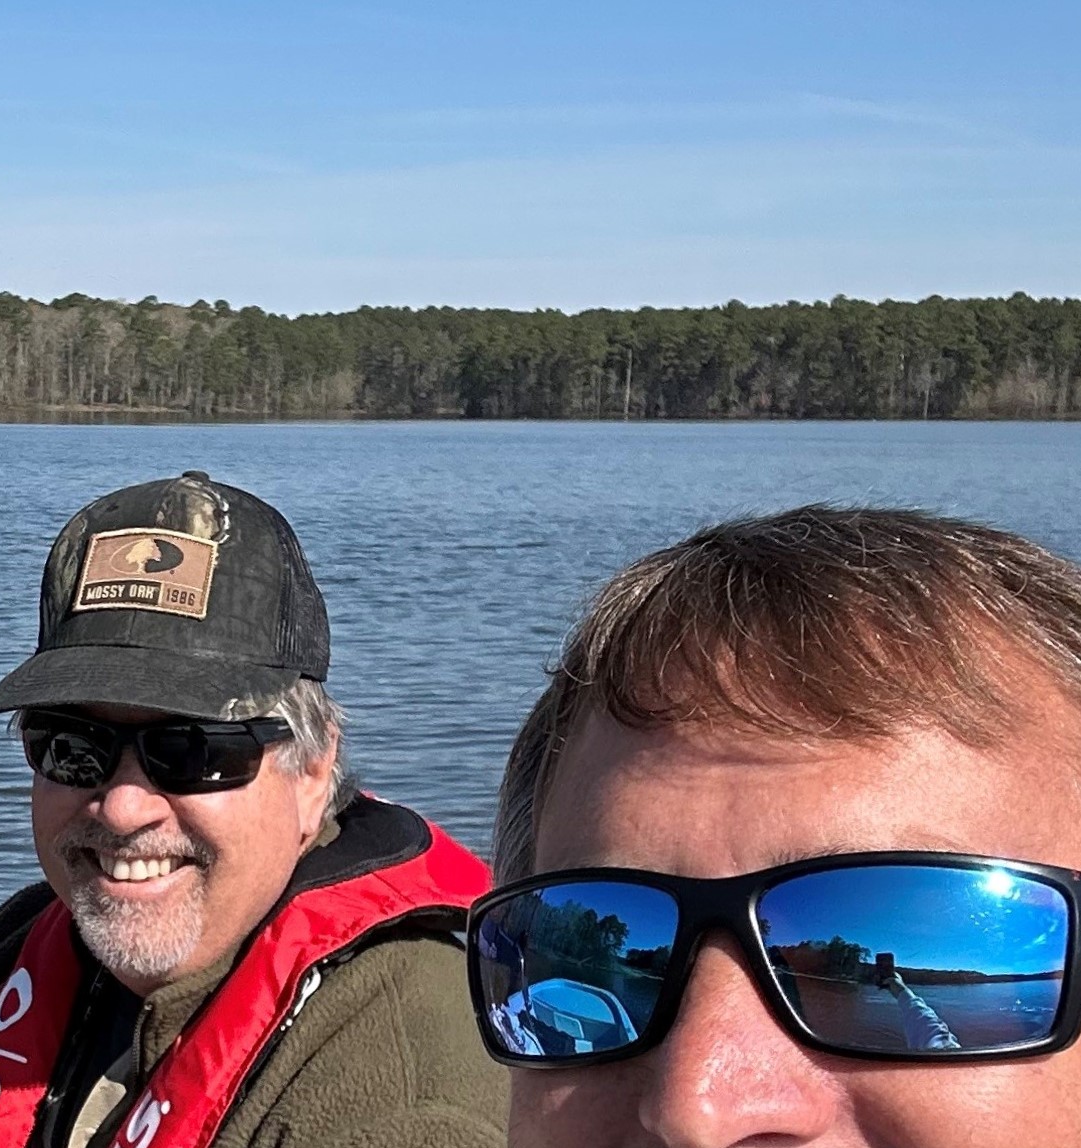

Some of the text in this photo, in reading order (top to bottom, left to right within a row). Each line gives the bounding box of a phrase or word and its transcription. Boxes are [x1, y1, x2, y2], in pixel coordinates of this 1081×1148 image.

[86, 584, 196, 606] MOSSY OAK 1986
